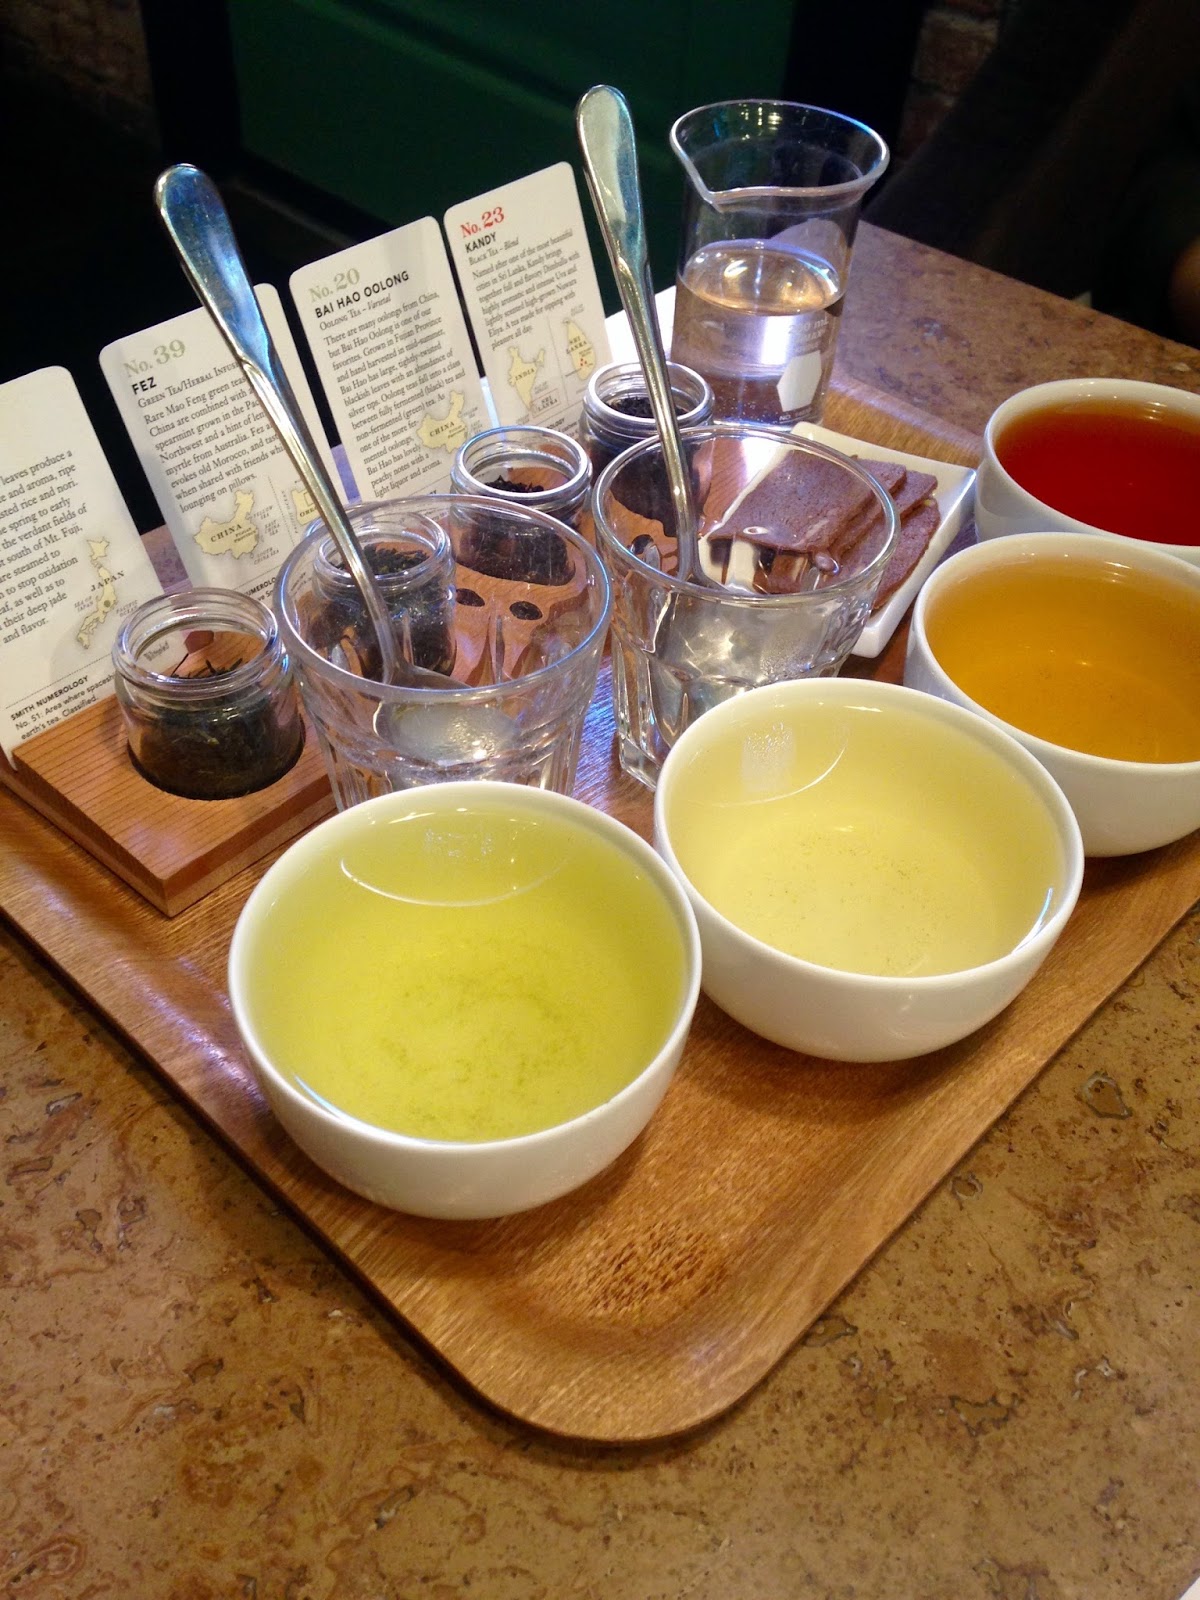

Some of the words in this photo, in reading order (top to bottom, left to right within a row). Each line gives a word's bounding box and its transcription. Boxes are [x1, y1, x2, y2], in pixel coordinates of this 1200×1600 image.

[460, 222, 481, 238] No.
[482, 207, 504, 228] 23
[465, 232, 496, 253] KANDY
[308, 285, 334, 303] No.
[334, 268, 360, 291] 20
[315, 303, 334, 318] BAI
[337, 292, 361, 309] HAO
[364, 271, 409, 297] OOLONG
[123, 359, 153, 378] No.
[154, 340, 185, 364] 39
[515, 368, 535, 381] INDIA
[132, 377, 157, 395] FEZ
[144, 412, 165, 425] Rare
[165, 403, 185, 416] Mao
[185, 394, 207, 407] Feng
[208, 384, 230, 400] green
[149, 423, 175, 437] China
[177, 416, 190, 426] are
[191, 396, 229, 420] combined
[230, 389, 247, 402] with
[155, 428, 195, 452] spearmint
[196, 417, 221, 435] grown
[222, 412, 231, 421] in
[232, 406, 245, 416] the
[160, 440, 203, 463] Northwest
[204, 430, 219, 444] and
[225, 422, 242, 434] hint
[243, 414, 252, 426] of
[166, 459, 192, 476] myrtle
[193, 450, 213, 463] from
[215, 434, 250, 454] Australia.
[250, 426, 265, 437] Fez
[0, 469, 29, 485] leaves
[29, 454, 65, 476] produce
[8, 484, 25, 499] and
[26, 474, 57, 491] aroma,
[58, 465, 76, 477] ripe
[171, 472, 197, 488] evokes
[198, 462, 212, 475] old
[212, 449, 249, 469] Morocco,
[250, 438, 264, 452] and
[175, 487, 198, 500] when
[199, 471, 224, 490] shared
[225, 464, 243, 477] with
[243, 452, 269, 469] friends
[20, 497, 38, 509] rice
[39, 486, 56, 501] and
[57, 478, 78, 493] nori.
[180, 492, 216, 513] lounging
[217, 487, 227, 496] on
[229, 474, 257, 493] pillows.
[1, 539, 17, 549] the
[18, 522, 52, 541] verdant
[53, 510, 76, 526] fields
[77, 503, 87, 515] of
[9, 513, 38, 532] spring
[38, 509, 49, 517] to
[50, 497, 70, 516] early
[211, 524, 242, 542] CHINA
[7, 546, 32, 564] south
[33, 538, 43, 551] of
[43, 534, 61, 546] Mt.
[61, 523, 83, 538] Fuji,
[5, 587, 16, 595] to
[17, 577, 37, 590] stop
[38, 557, 78, 579] oxidation
[14, 552, 50, 576] steamed
[50, 550, 61, 559] to
[91, 571, 124, 592] JAPAN
[3, 613, 24, 628] their
[27, 602, 48, 616] deep
[48, 592, 67, 608] jade
[14, 599, 24, 607] as
[25, 586, 43, 601] well
[45, 583, 54, 593] as
[54, 579, 65, 587] to
[3, 629, 20, 644] and
[21, 618, 48, 635] flavor.
[11, 705, 35, 721] SMITH
[36, 676, 87, 707] NUMEROLOGY
[15, 721, 30, 730] No.
[31, 713, 43, 722] 51:
[45, 703, 62, 715] Area
[63, 691, 85, 705] where
[21, 724, 46, 740] earth's
[46, 717, 61, 726] tea.
[62, 695, 98, 717] Classified.
